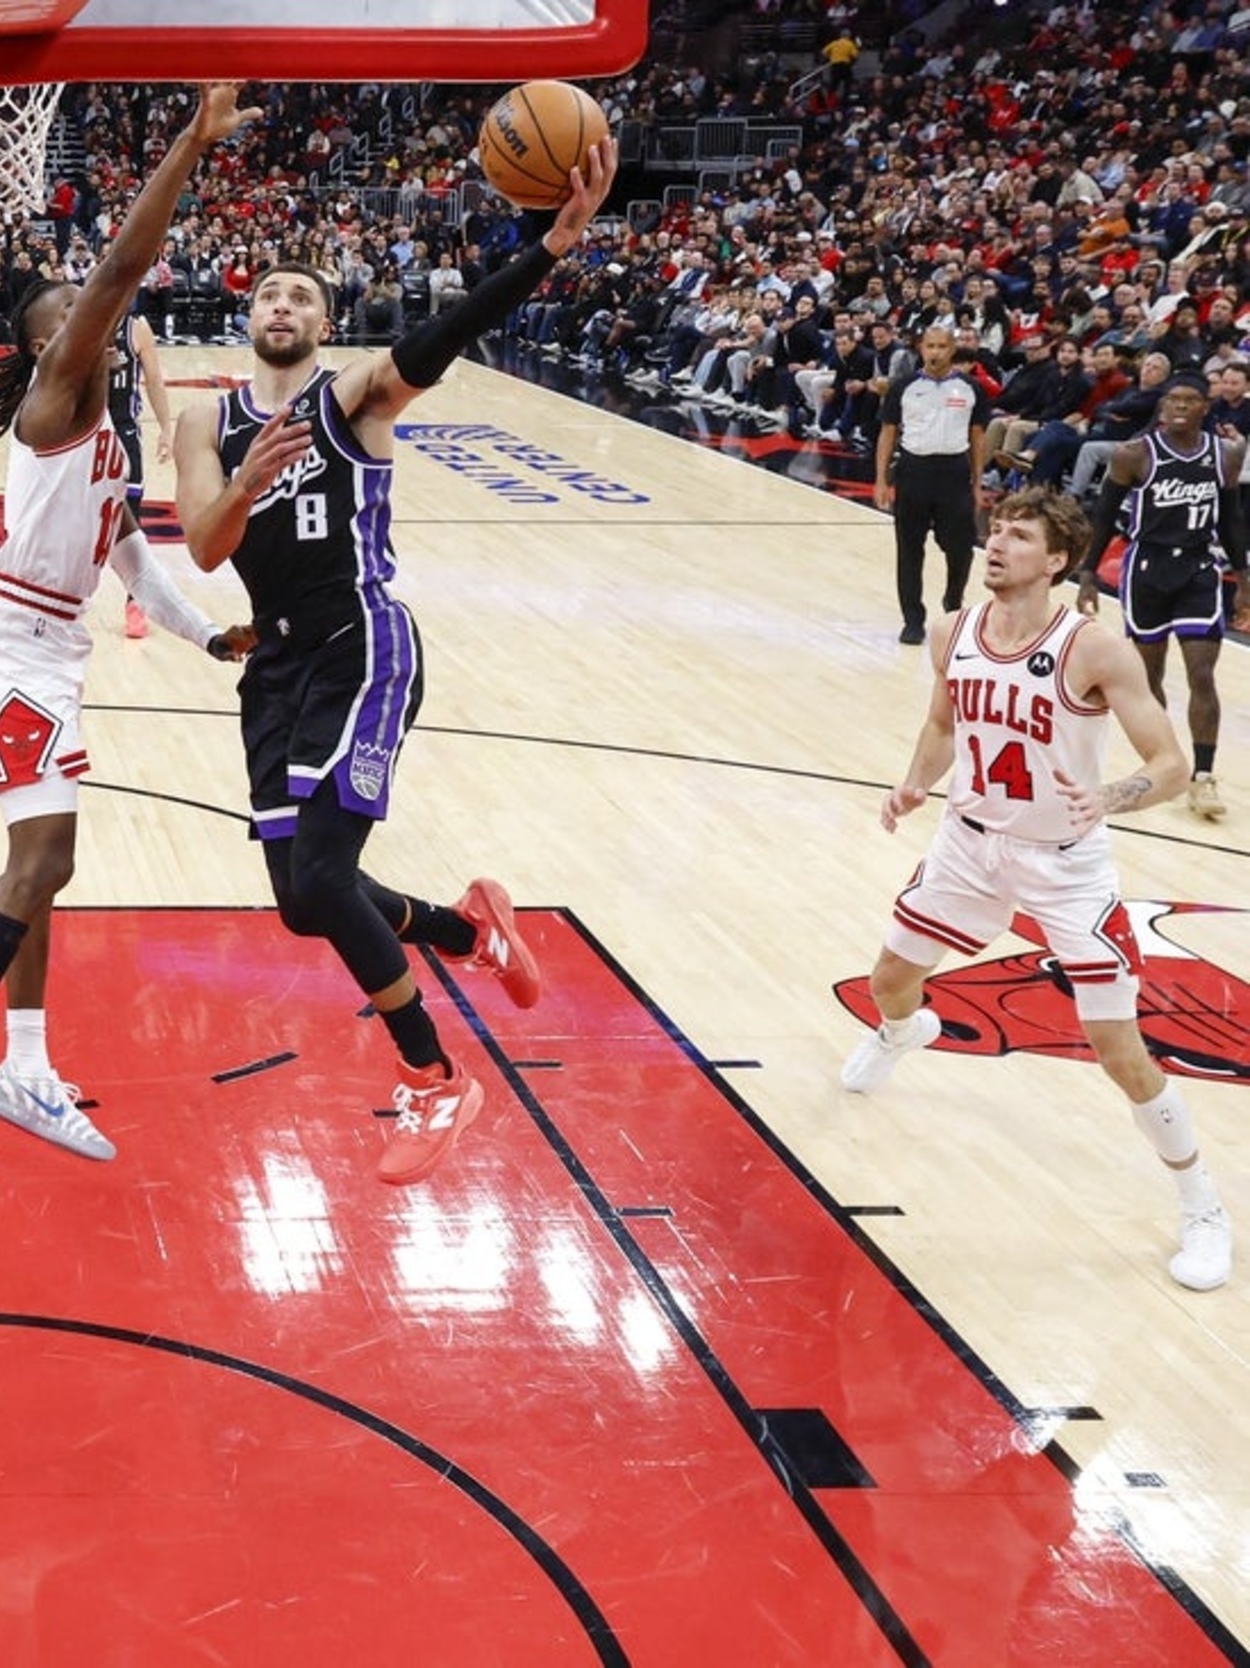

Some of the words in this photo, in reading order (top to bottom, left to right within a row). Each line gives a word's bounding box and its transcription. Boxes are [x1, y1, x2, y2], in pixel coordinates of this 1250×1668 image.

[414, 444, 560, 503] UNITED
[493, 444, 651, 504] CENTER
[1150, 478, 1217, 508] Kings
[295, 493, 328, 541] 8
[1187, 504, 1211, 530] 17
[968, 734, 1034, 802] 14
